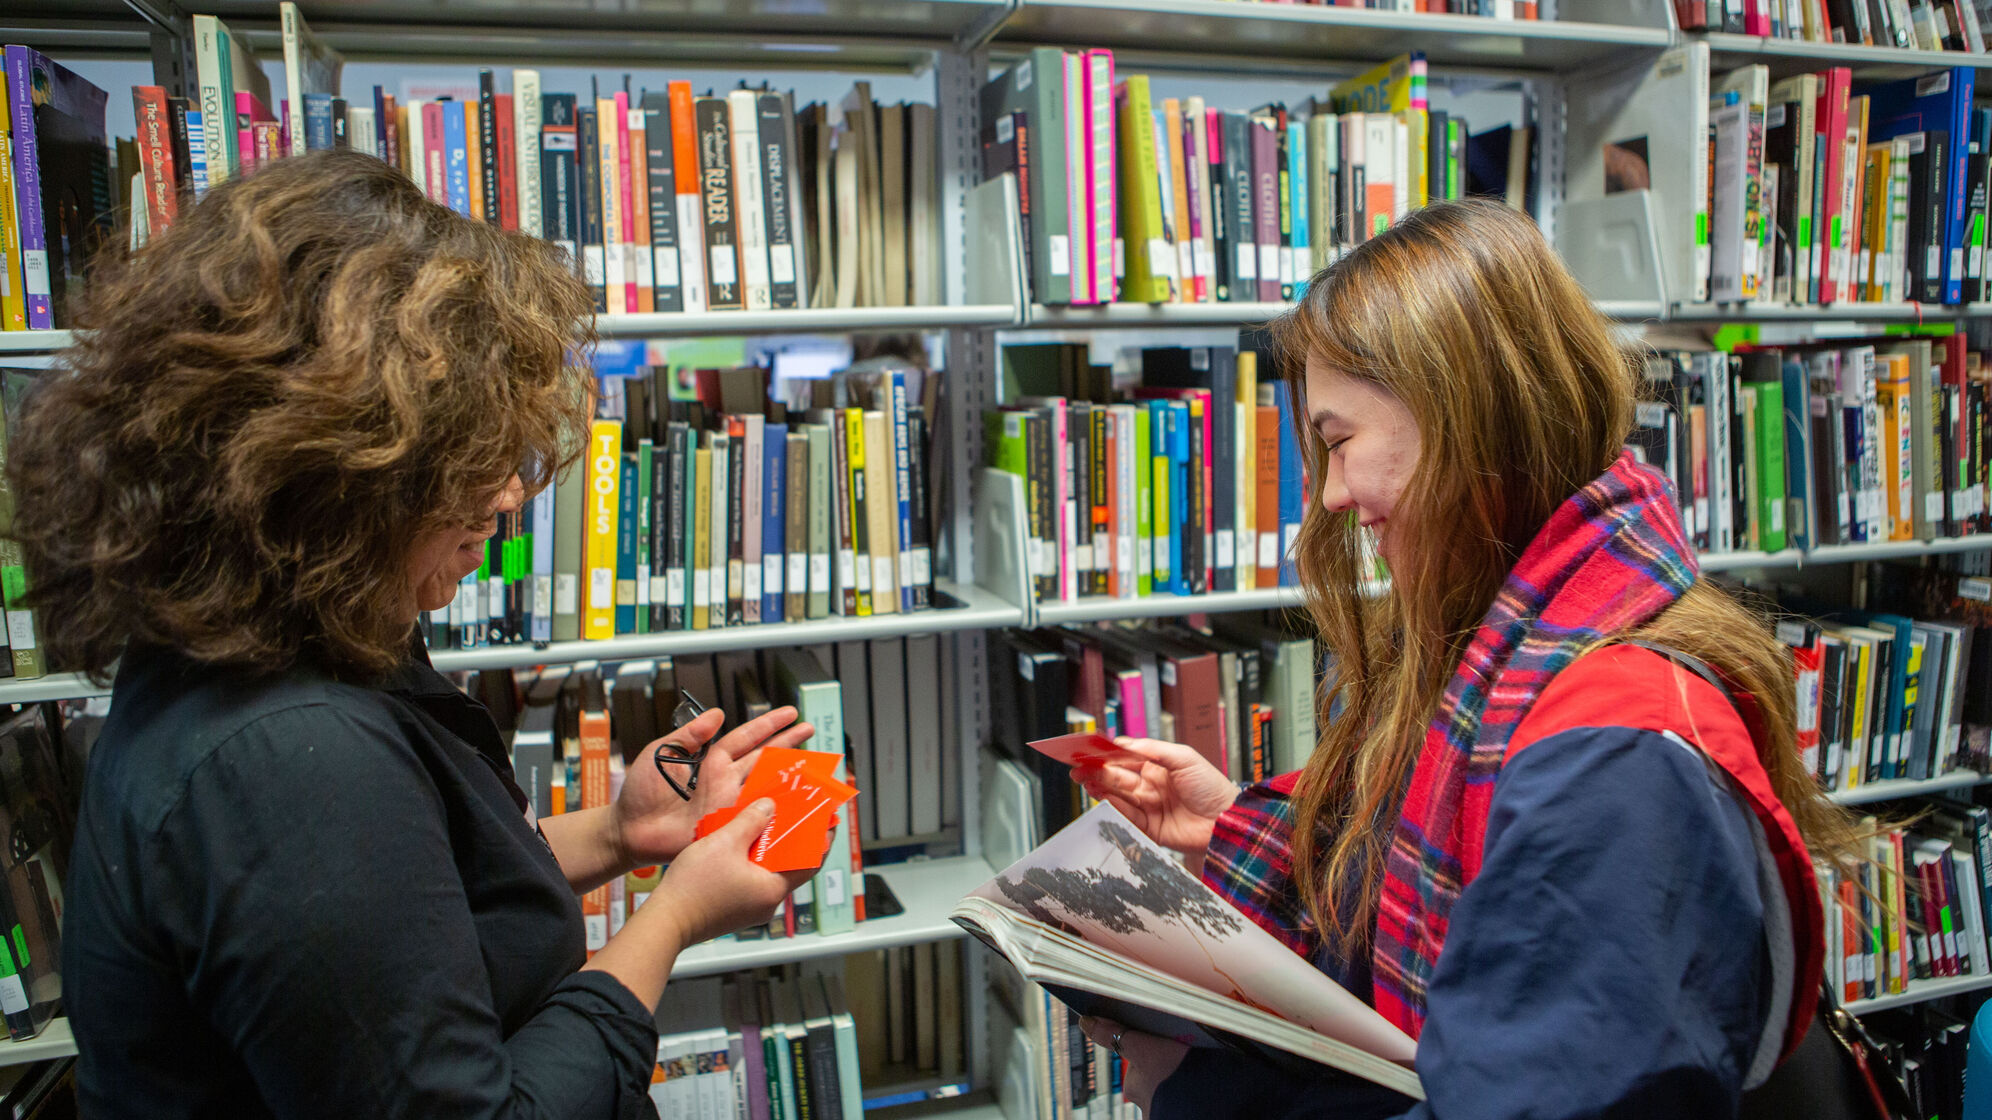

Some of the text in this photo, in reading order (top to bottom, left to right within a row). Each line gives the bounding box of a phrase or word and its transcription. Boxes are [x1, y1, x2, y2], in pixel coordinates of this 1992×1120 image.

[19, 104, 30, 132] Latin
[523, 83, 538, 127] VISUAL
[1340, 79, 1391, 114] ODE
[204, 86, 221, 160] EVOLUTION
[714, 123, 730, 169] Cultural
[146, 102, 168, 216] The Smell Culture Reader
[704, 169, 729, 225] READER
[594, 435, 616, 536] TOOLS
[824, 713, 833, 732] The
